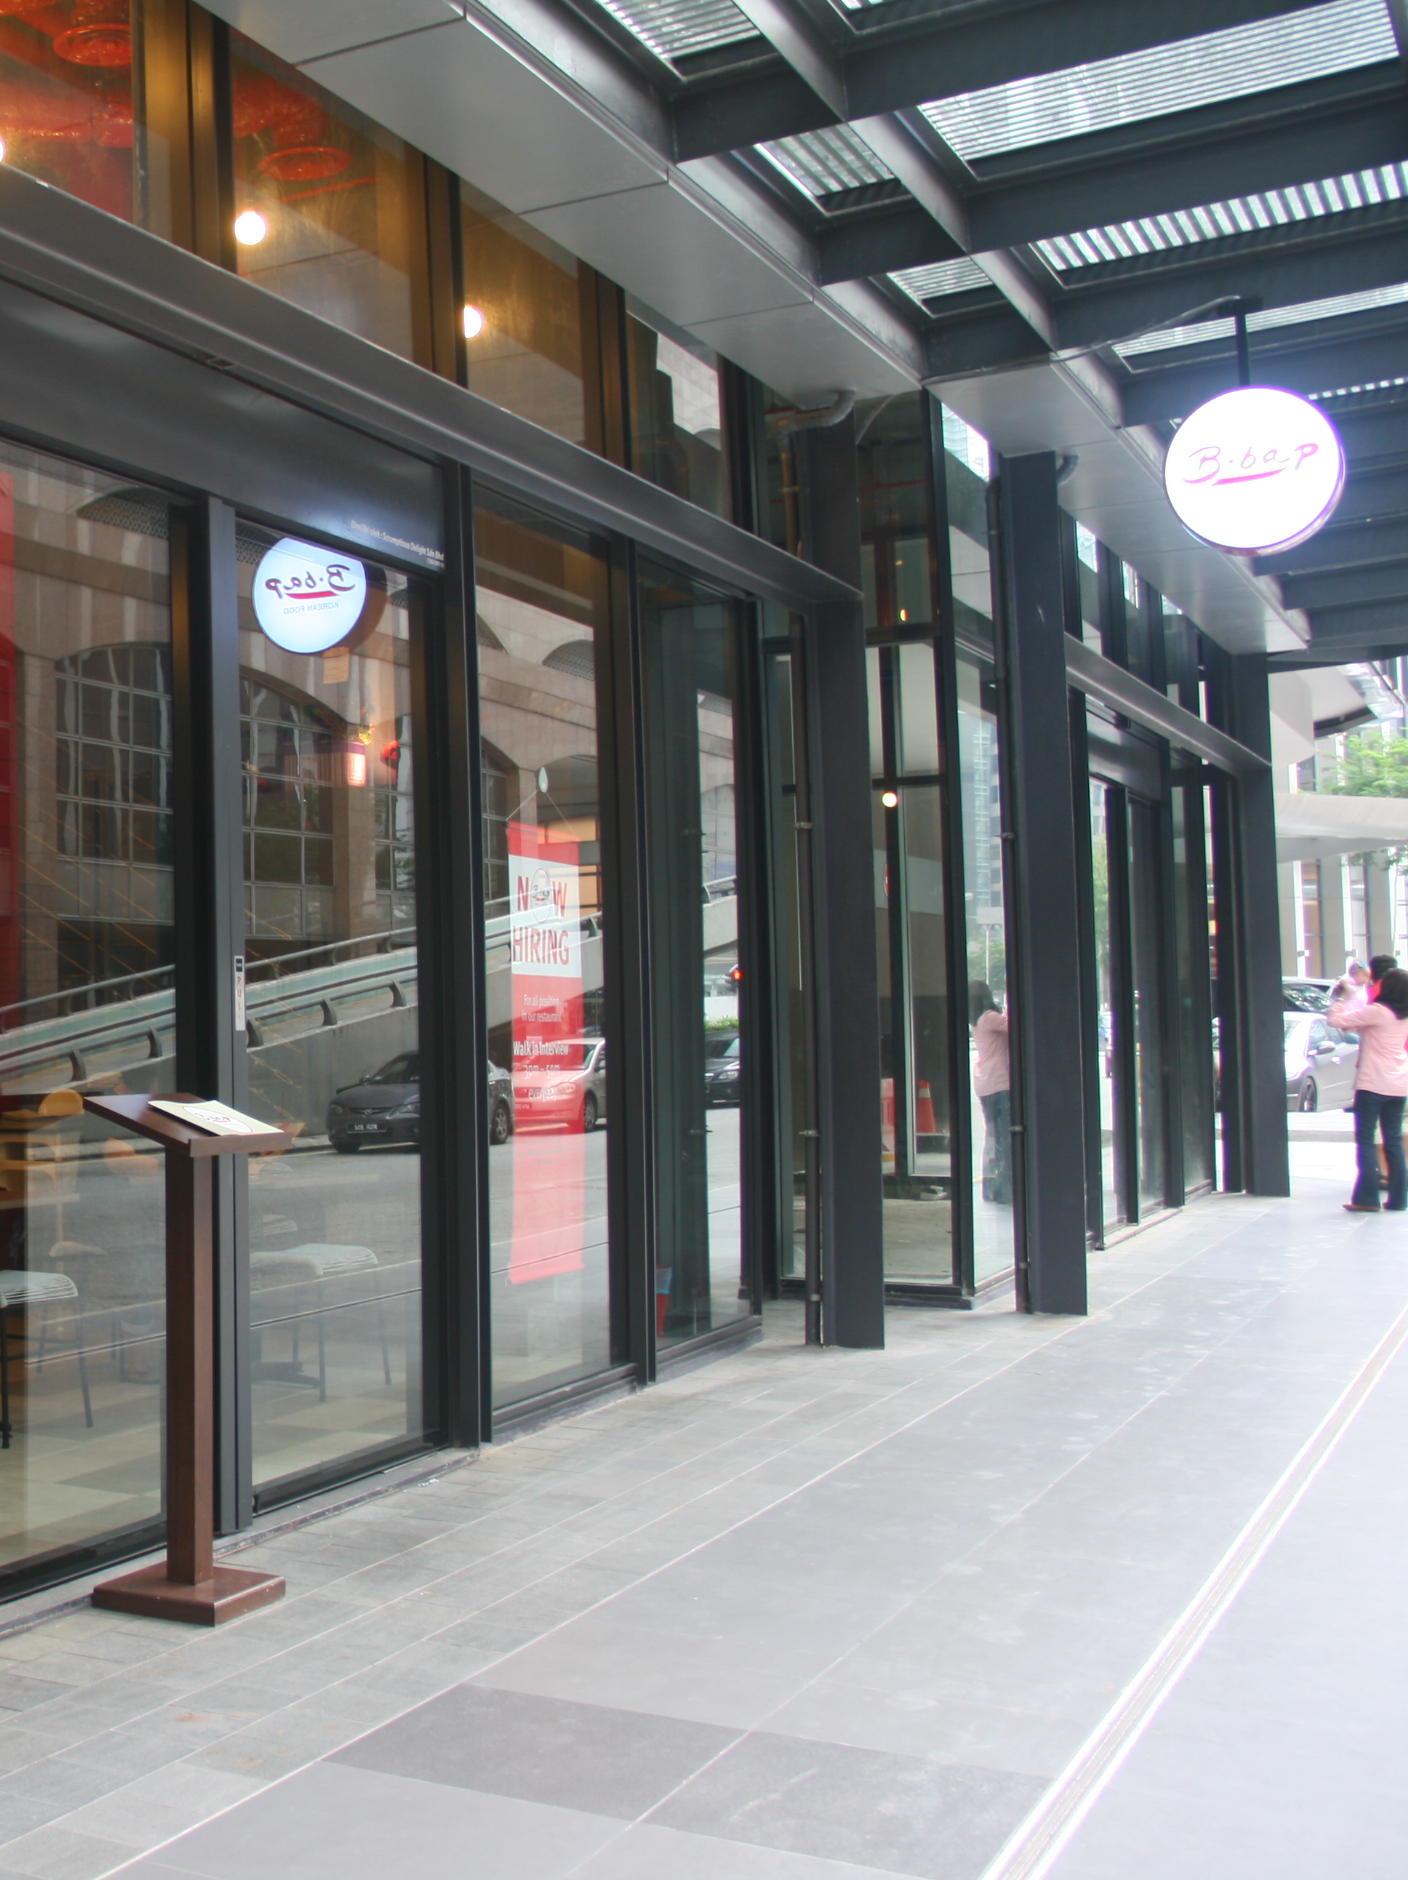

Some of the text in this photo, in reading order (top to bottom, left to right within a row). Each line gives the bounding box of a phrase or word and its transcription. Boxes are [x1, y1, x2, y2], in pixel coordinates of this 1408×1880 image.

[512, 926, 569, 965] HIRING
[513, 1040, 570, 1056] Walk in Interview
